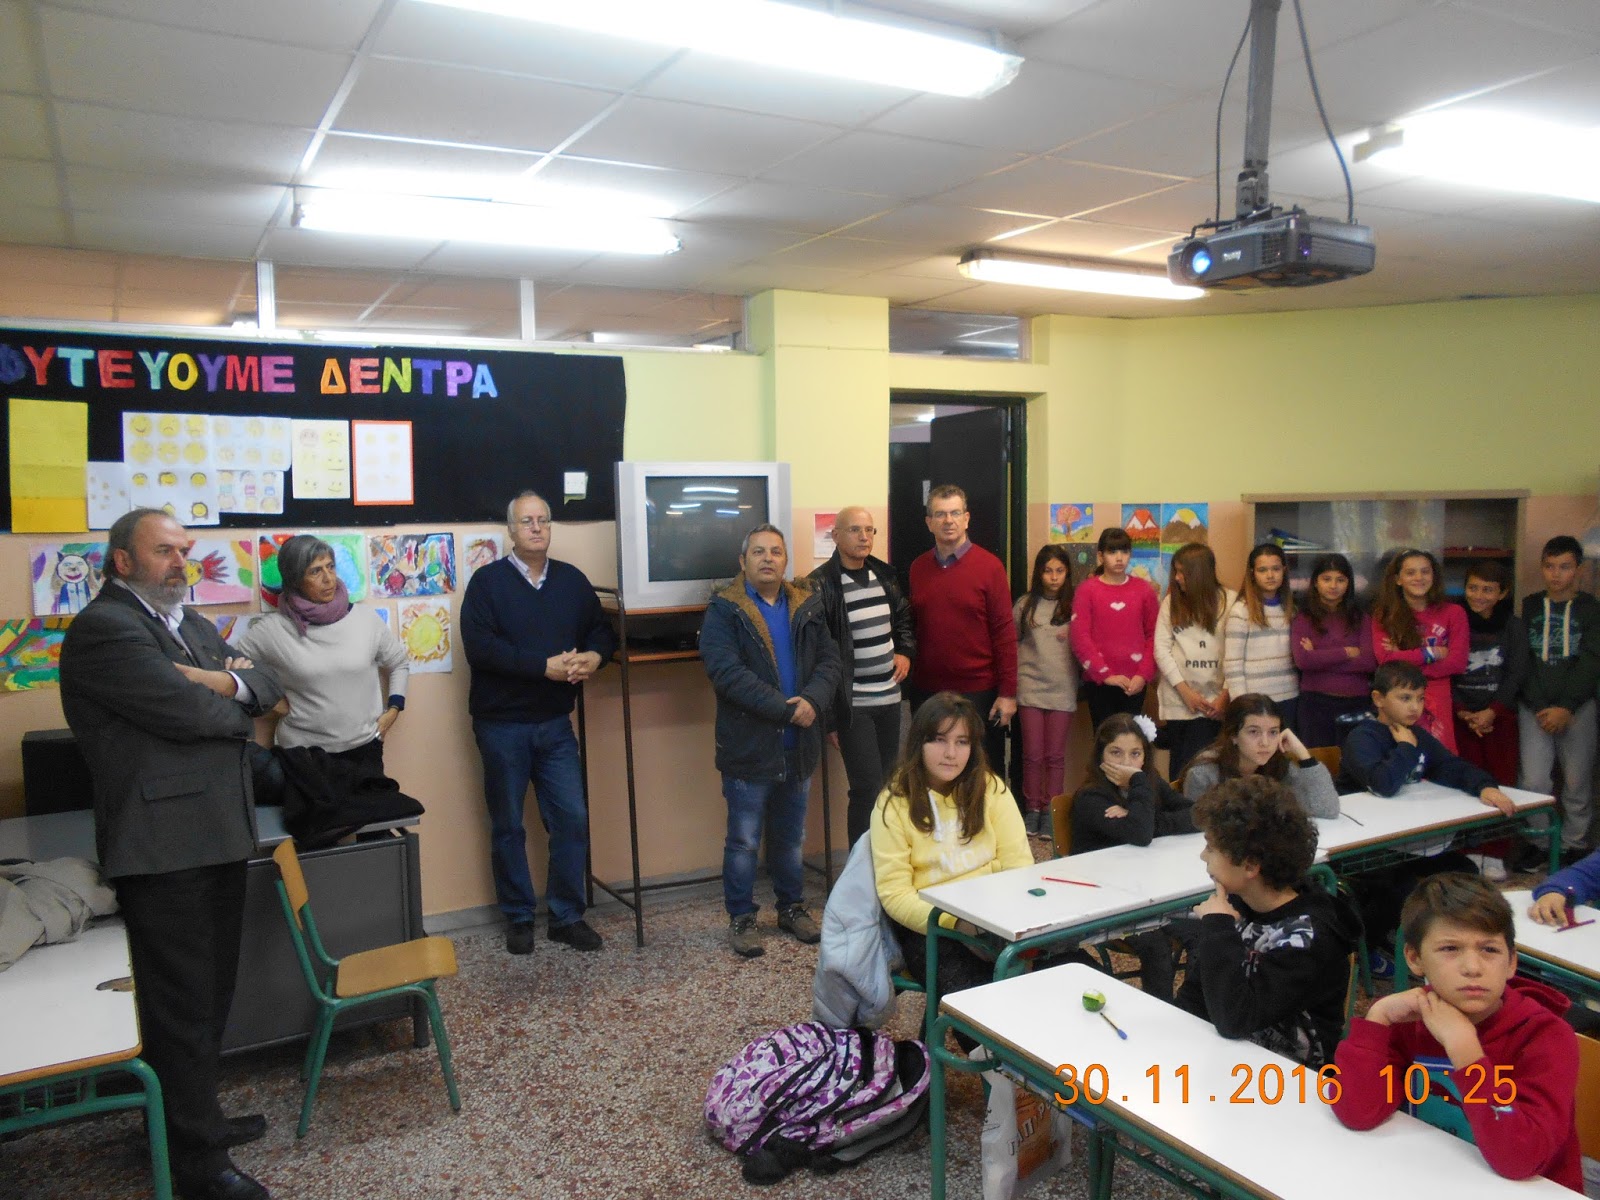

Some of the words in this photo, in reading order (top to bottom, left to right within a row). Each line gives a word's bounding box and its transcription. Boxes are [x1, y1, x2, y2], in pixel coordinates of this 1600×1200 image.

[320, 357, 498, 398] ΔΕΝΤΡΑ
[1199, 640, 1207, 648] A
[1185, 660, 1219, 668] PARTY
